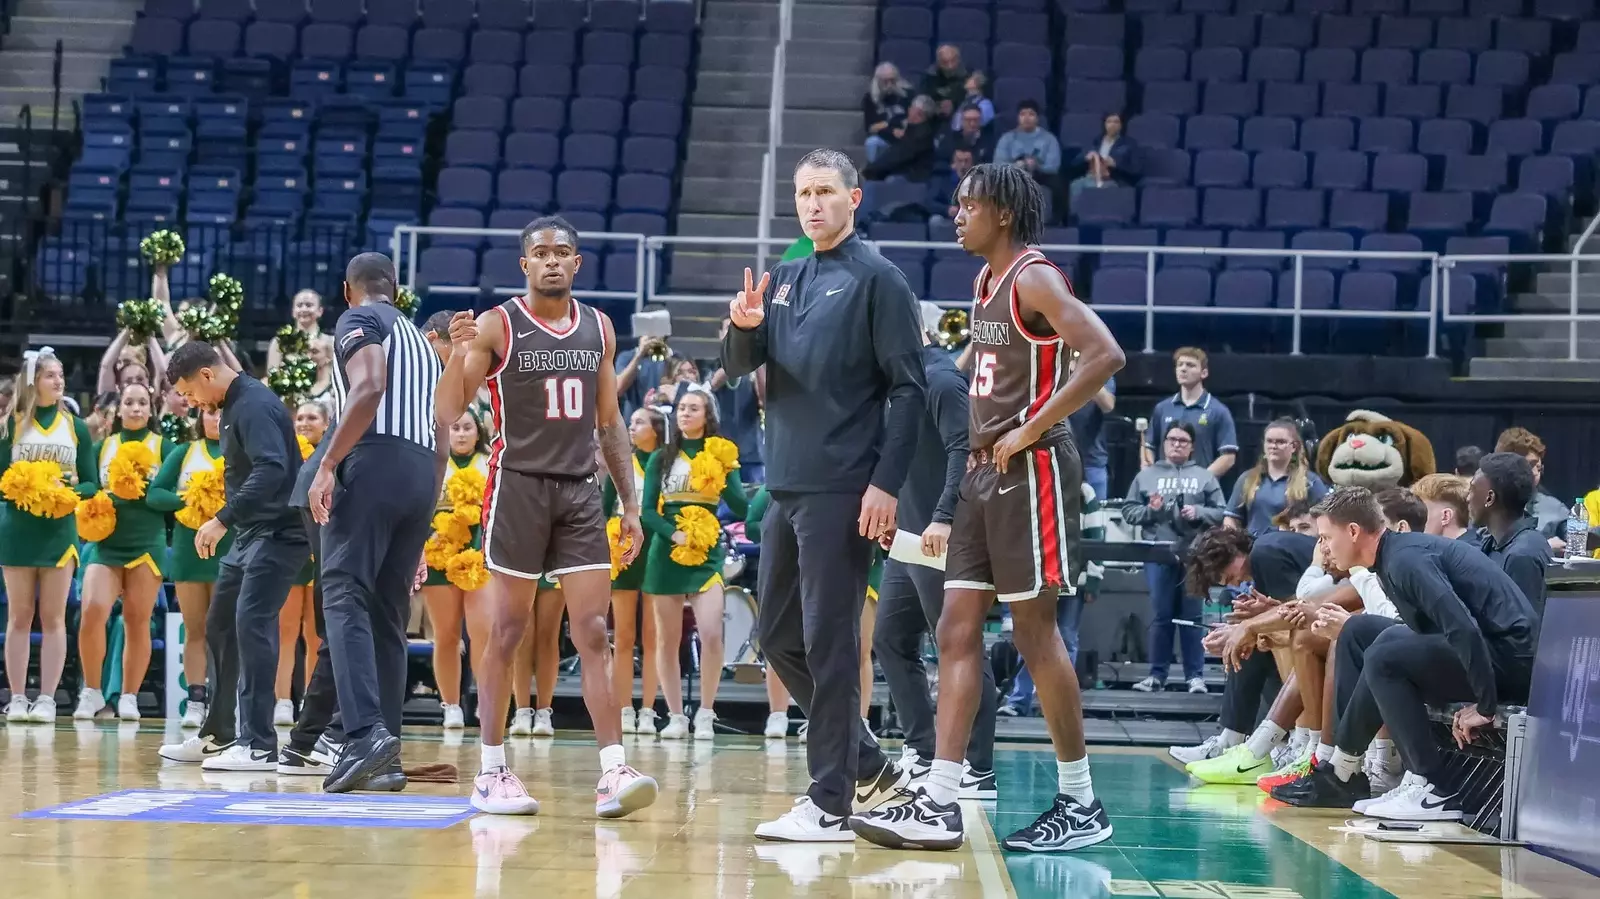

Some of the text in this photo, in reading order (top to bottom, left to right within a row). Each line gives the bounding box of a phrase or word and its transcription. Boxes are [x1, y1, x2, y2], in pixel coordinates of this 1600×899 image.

[518, 350, 601, 372] BROWN
[969, 351, 997, 397] 15
[544, 376, 584, 420] 10
